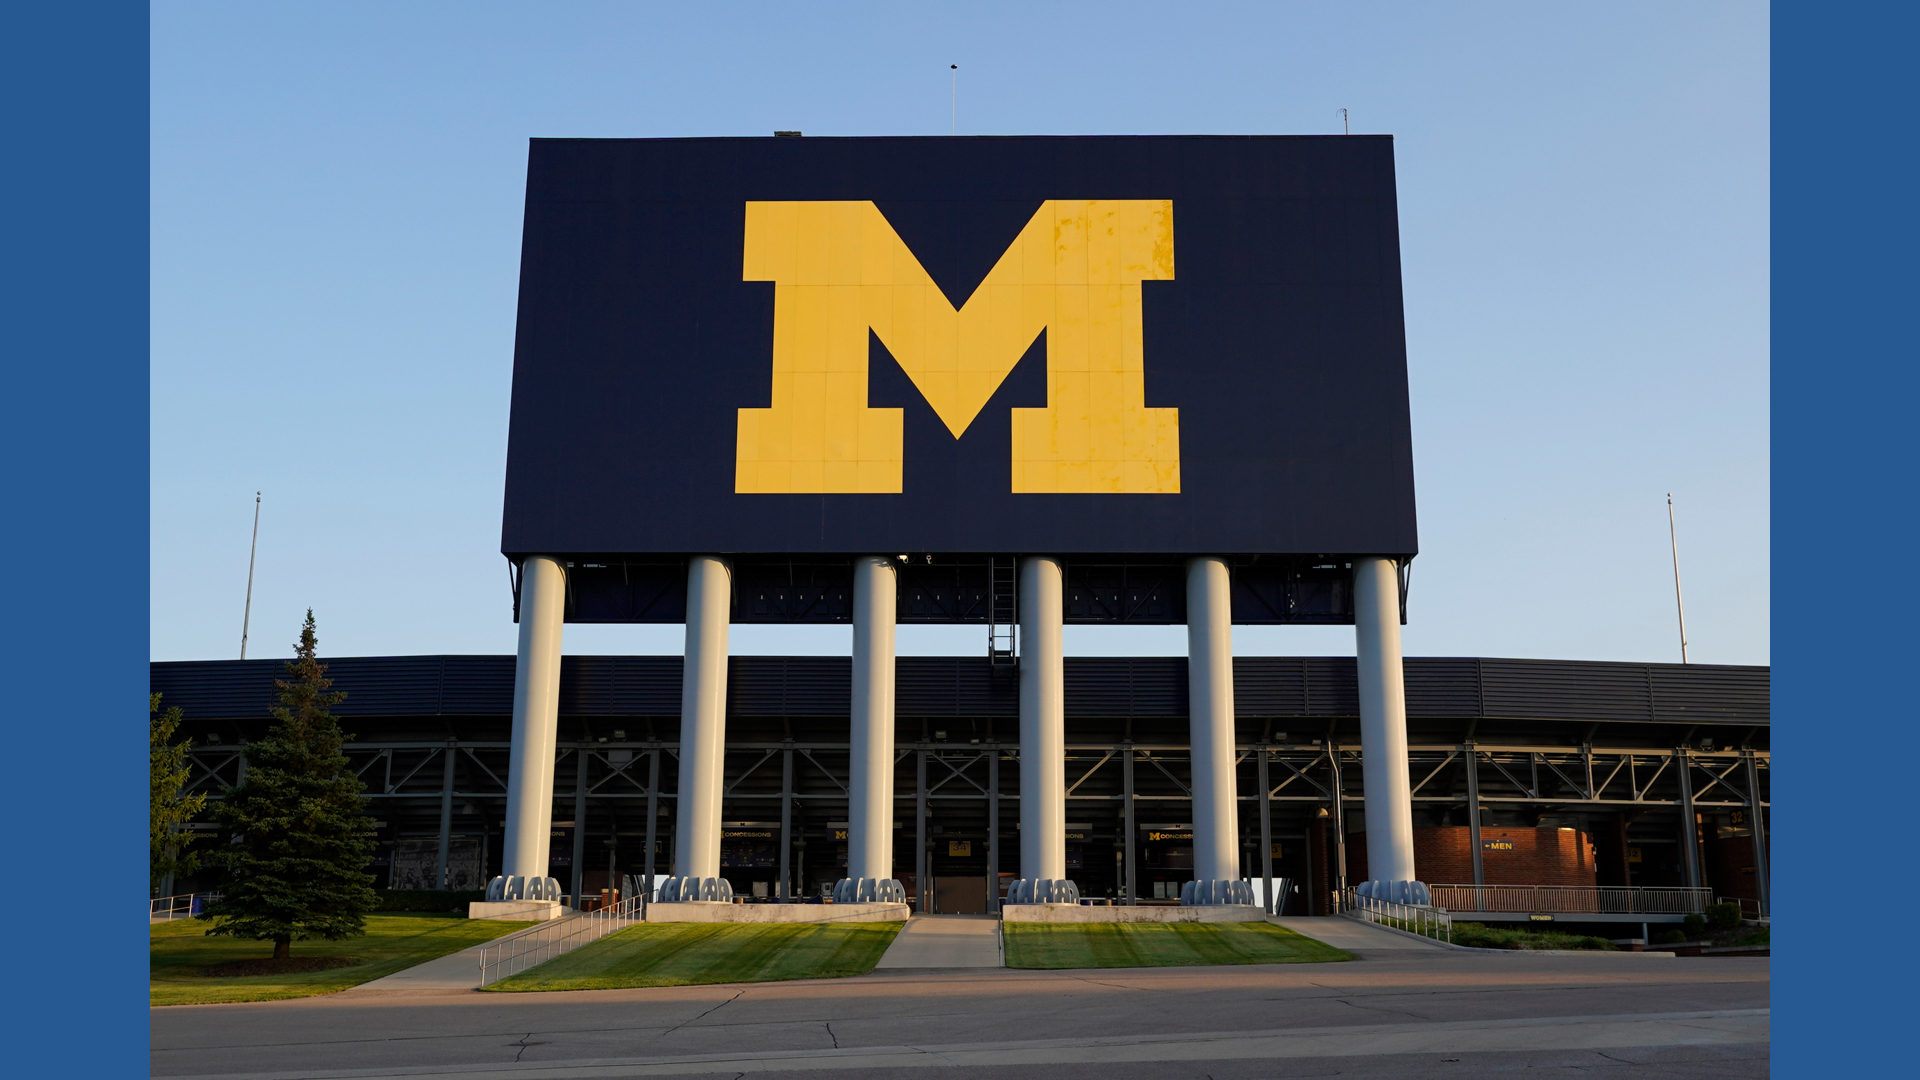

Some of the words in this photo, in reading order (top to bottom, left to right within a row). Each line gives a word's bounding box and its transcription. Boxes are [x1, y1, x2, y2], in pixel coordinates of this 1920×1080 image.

[735, 200, 1180, 494] M
[1730, 811, 1742, 823] 32
[835, 831, 847, 839] M
[1149, 832, 1160, 841] M
[953, 844, 967, 852] 34
[1491, 842, 1512, 850] MEN
